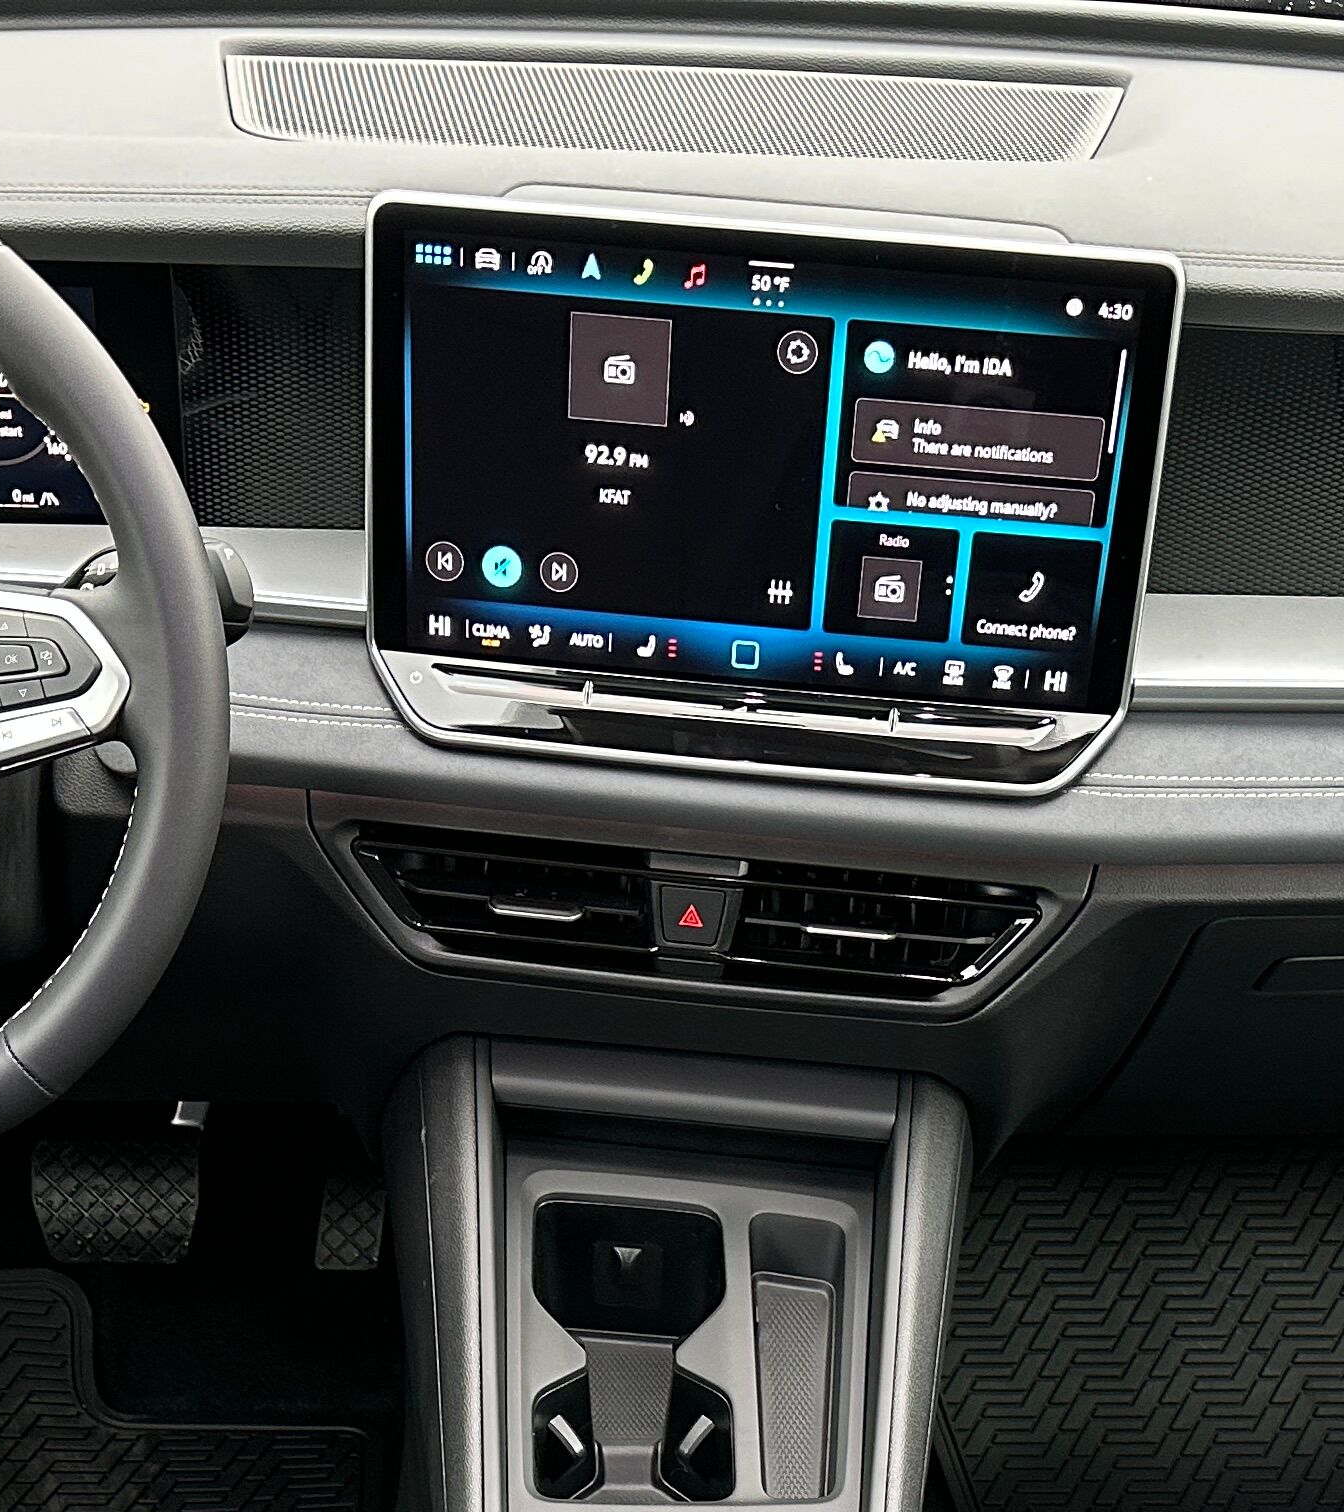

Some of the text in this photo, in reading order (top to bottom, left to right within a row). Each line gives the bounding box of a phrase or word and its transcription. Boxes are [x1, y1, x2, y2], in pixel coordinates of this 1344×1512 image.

[751, 274, 771, 292] 50
[1098, 302, 1134, 321] 4:30
[908, 351, 1013, 377] Hello, I'm IDA
[914, 418, 942, 436] Info
[584, 444, 649, 469] 92.9 FM
[912, 437, 1054, 464] There are notifications
[599, 488, 632, 506] KFAT
[906, 491, 1058, 519] No adjusting manually?
[879, 533, 910, 549] Radio
[429, 614, 451, 637] HI
[472, 622, 511, 640] CLIMA
[976, 618, 1079, 642] Connect phone?
[569, 631, 604, 649] AUTO
[1043, 669, 1068, 693] HI
